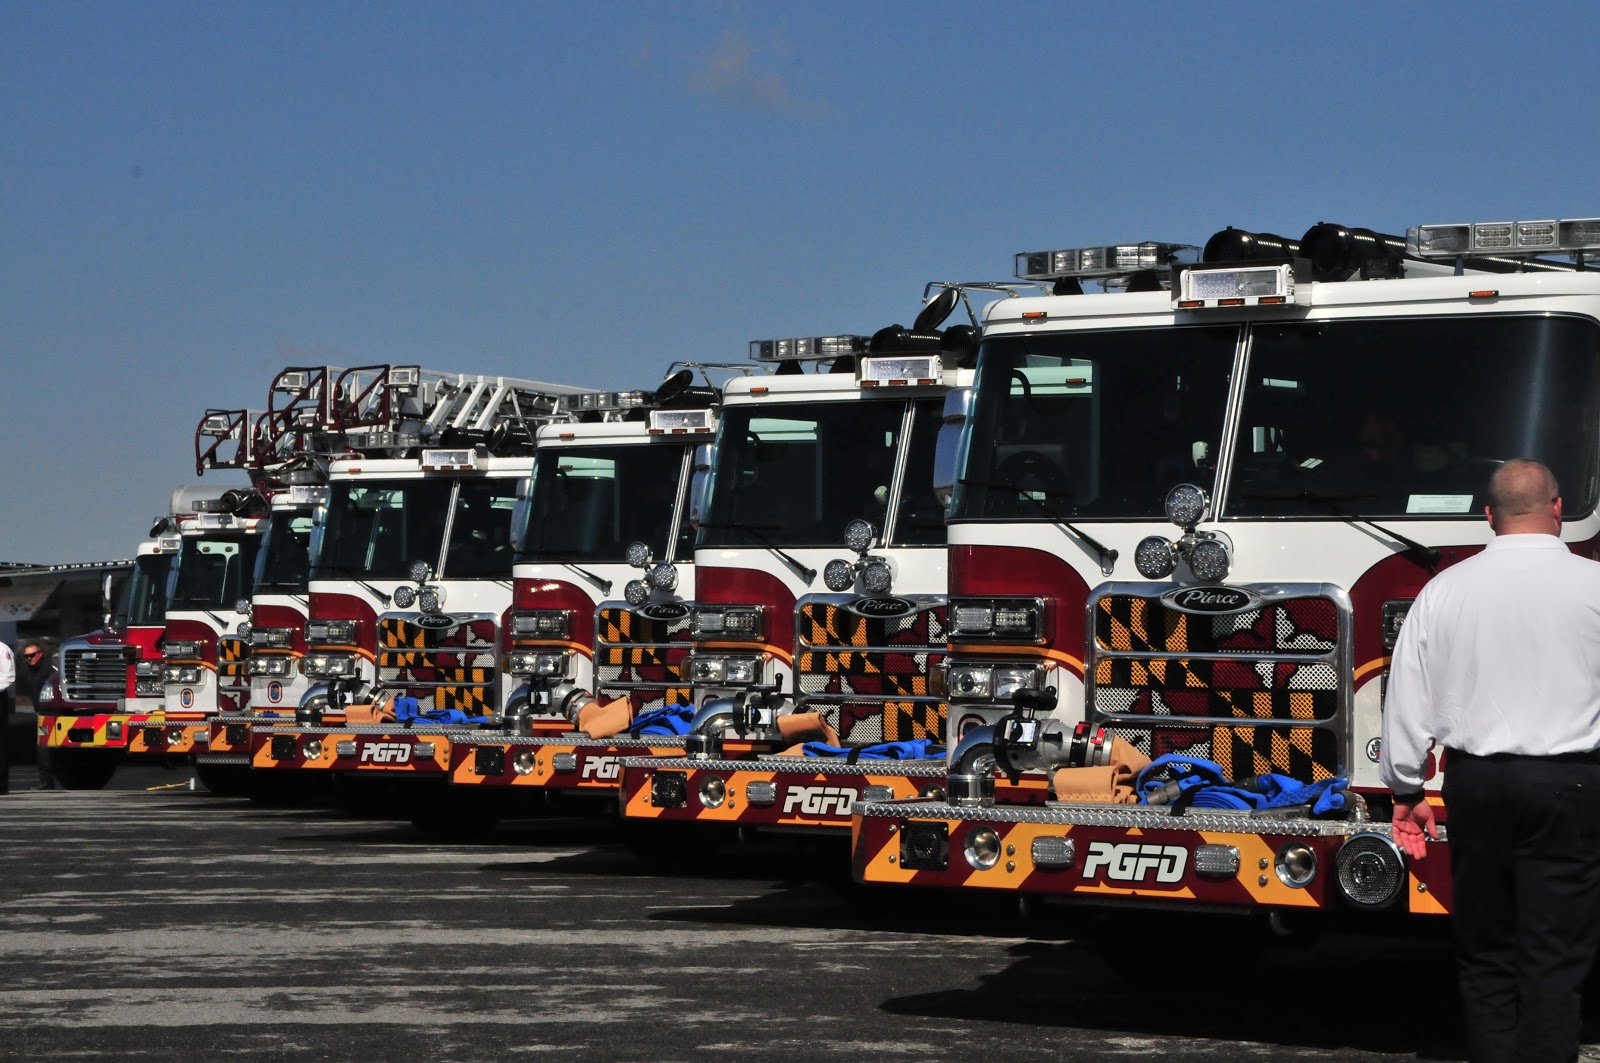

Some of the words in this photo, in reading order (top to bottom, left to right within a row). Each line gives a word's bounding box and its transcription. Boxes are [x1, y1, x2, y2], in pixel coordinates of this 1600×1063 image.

[1183, 590, 1239, 606] Pierce
[361, 742, 411, 763] PGFD
[582, 755, 620, 779] PG
[783, 785, 858, 816] PGFD
[1082, 842, 1188, 883] PGFD
